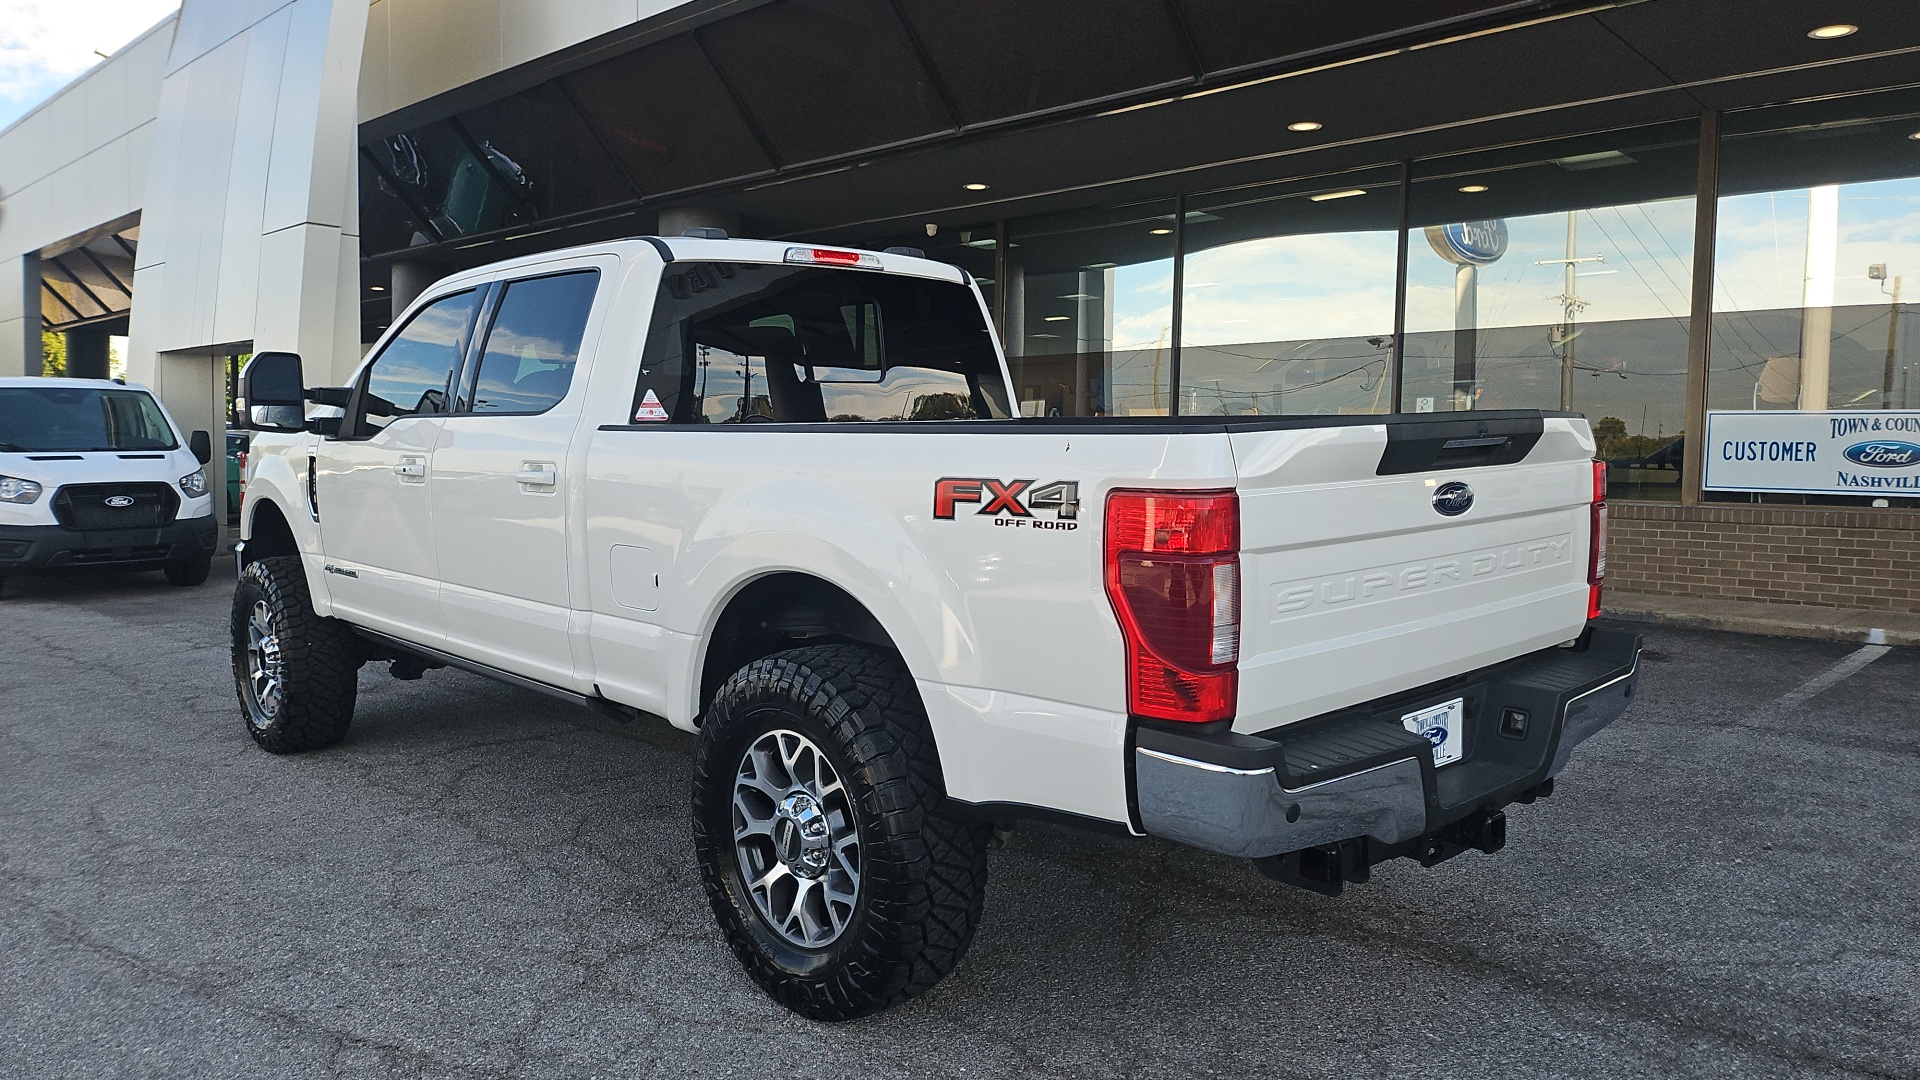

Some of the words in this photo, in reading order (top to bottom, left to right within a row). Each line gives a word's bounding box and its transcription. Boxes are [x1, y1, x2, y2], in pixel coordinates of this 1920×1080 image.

[1830, 417, 1869, 439] TOWN
[1871, 417, 1882, 431] &
[1723, 441, 1817, 462] CUSTOMER
[1860, 444, 1913, 463] Ford
[932, 476, 1081, 521] FX4
[994, 518, 1027, 528] OFF
[1032, 520, 1078, 531] ROAD
[1276, 560, 1460, 614] SUPER
[1472, 539, 1569, 577] DUTY
